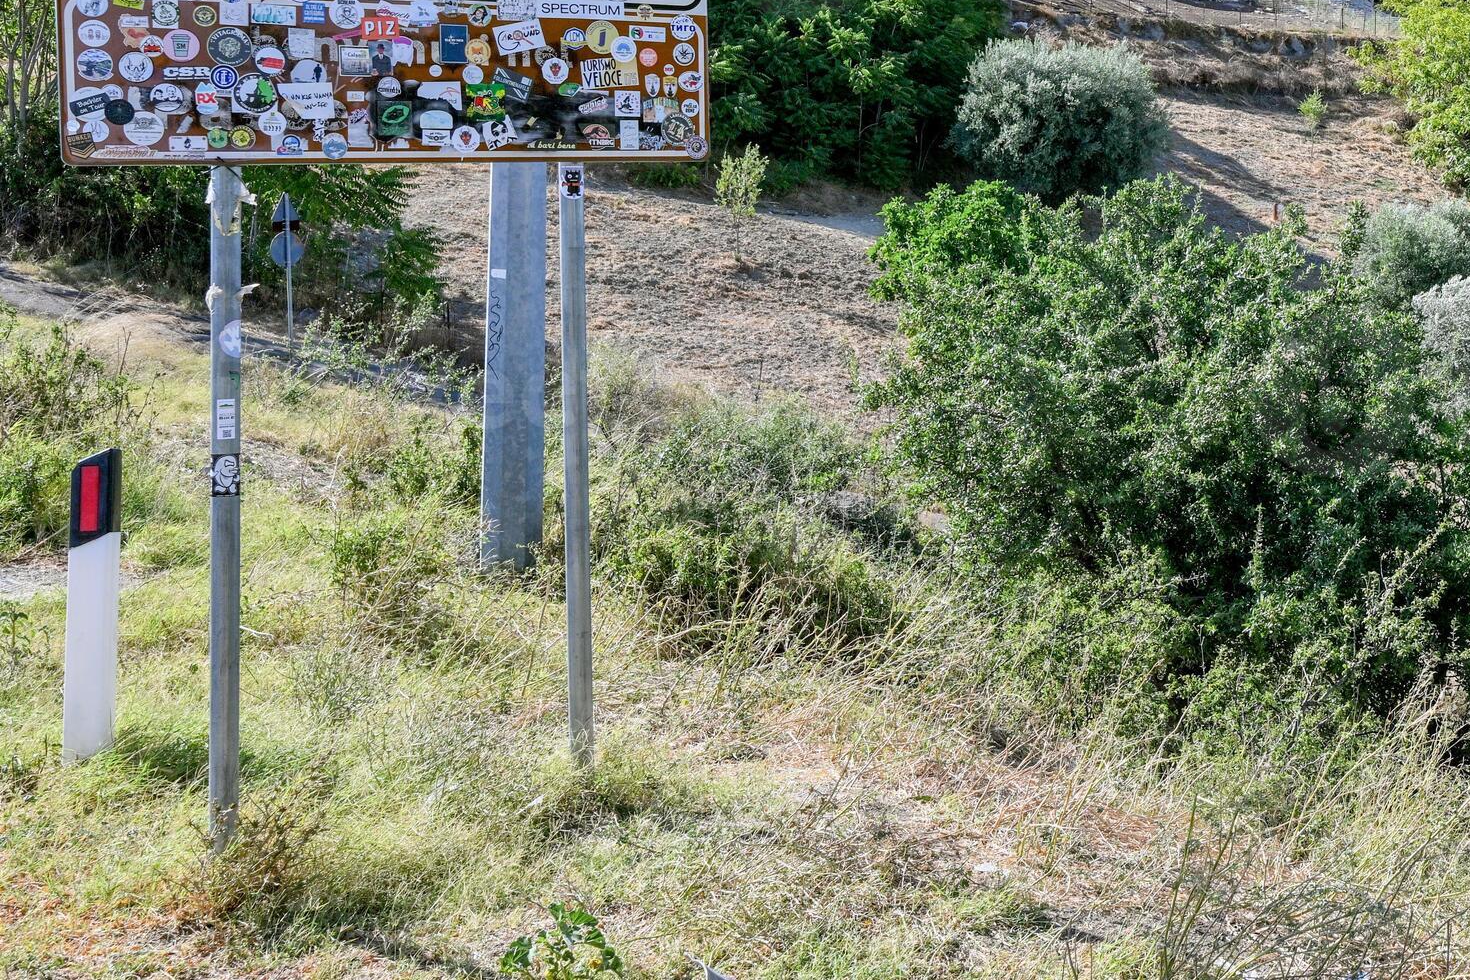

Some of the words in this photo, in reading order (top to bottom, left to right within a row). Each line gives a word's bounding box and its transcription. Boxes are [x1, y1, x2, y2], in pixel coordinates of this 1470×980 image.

[541, 3, 621, 16] SPECTRUM
[364, 20, 395, 35] PIZ
[582, 59, 617, 71] TURISMO
[583, 70, 622, 88] VELOCE
[556, 141, 576, 149] bene
